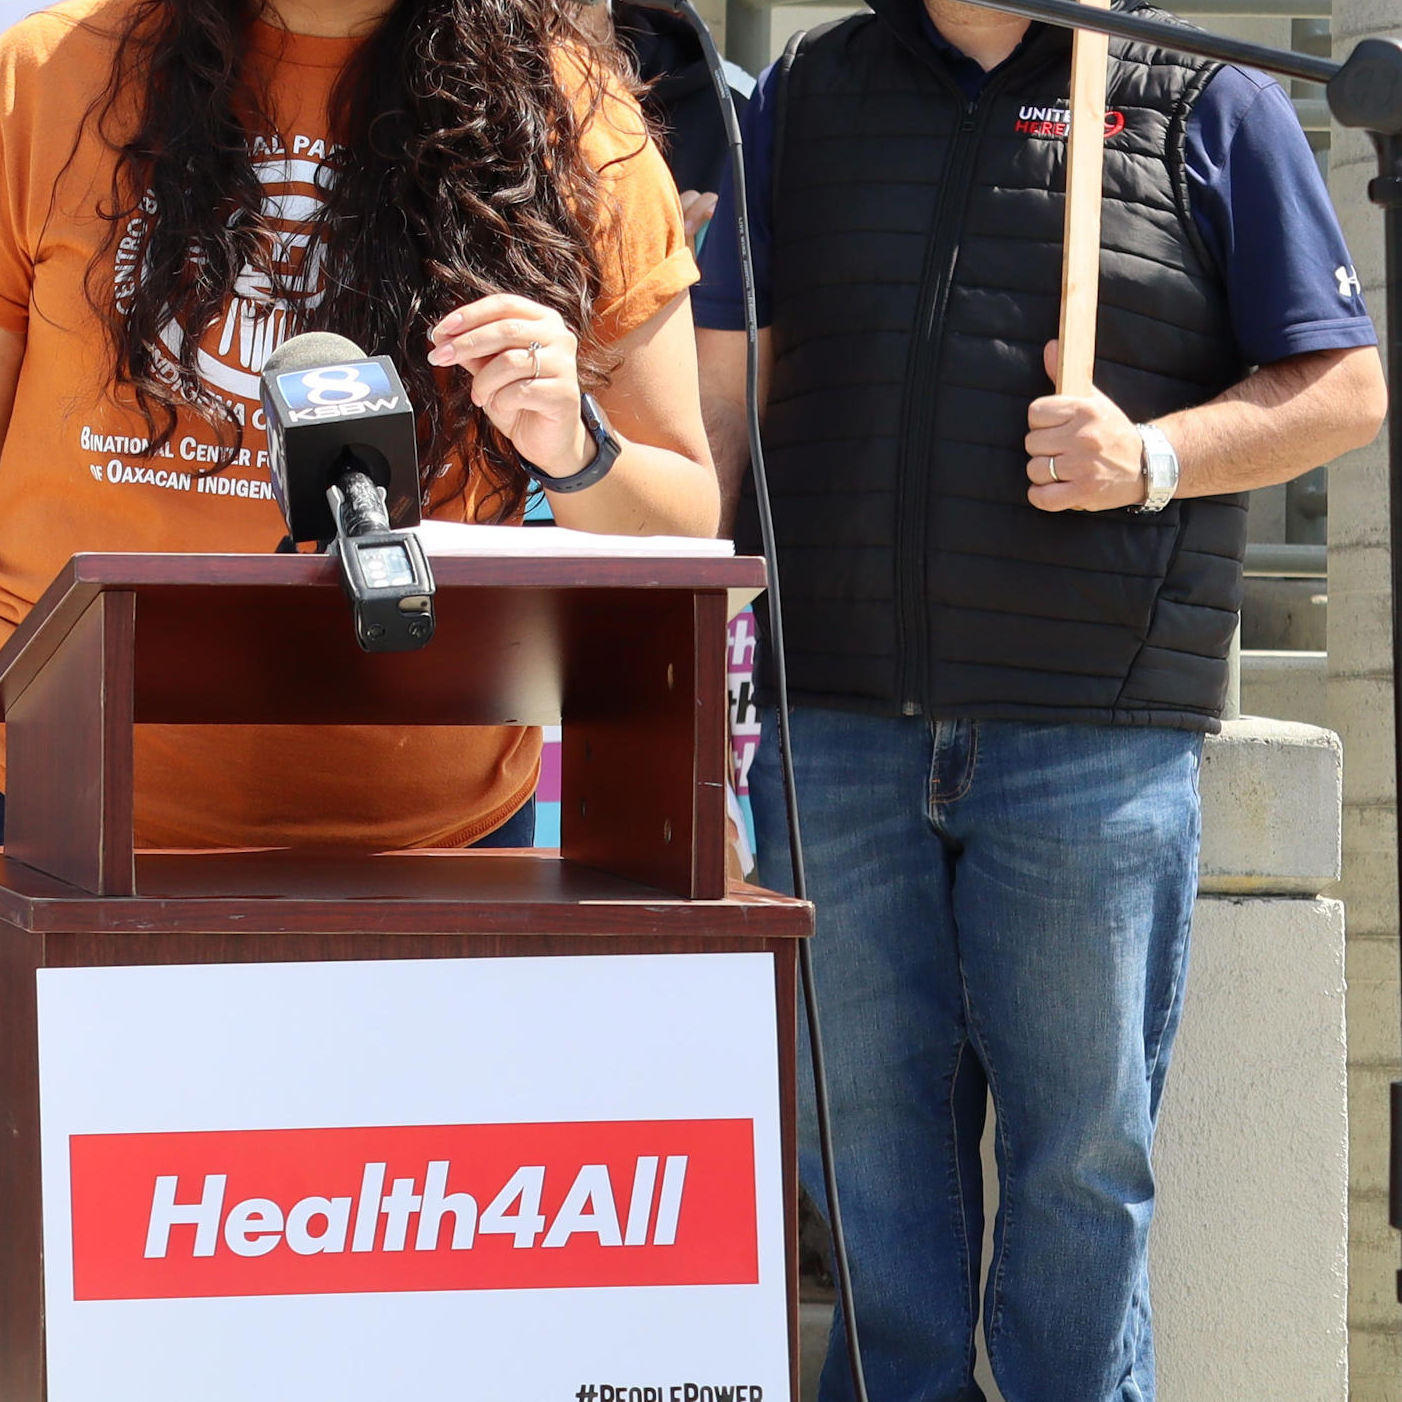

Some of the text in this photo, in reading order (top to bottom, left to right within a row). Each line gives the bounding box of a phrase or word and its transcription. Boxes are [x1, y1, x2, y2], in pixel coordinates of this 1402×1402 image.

[302, 366, 371, 406] 8
[288, 396, 399, 423] KSBW
[106, 458, 192, 492] OAXACAN
[143, 1155, 688, 1260] Health4All
